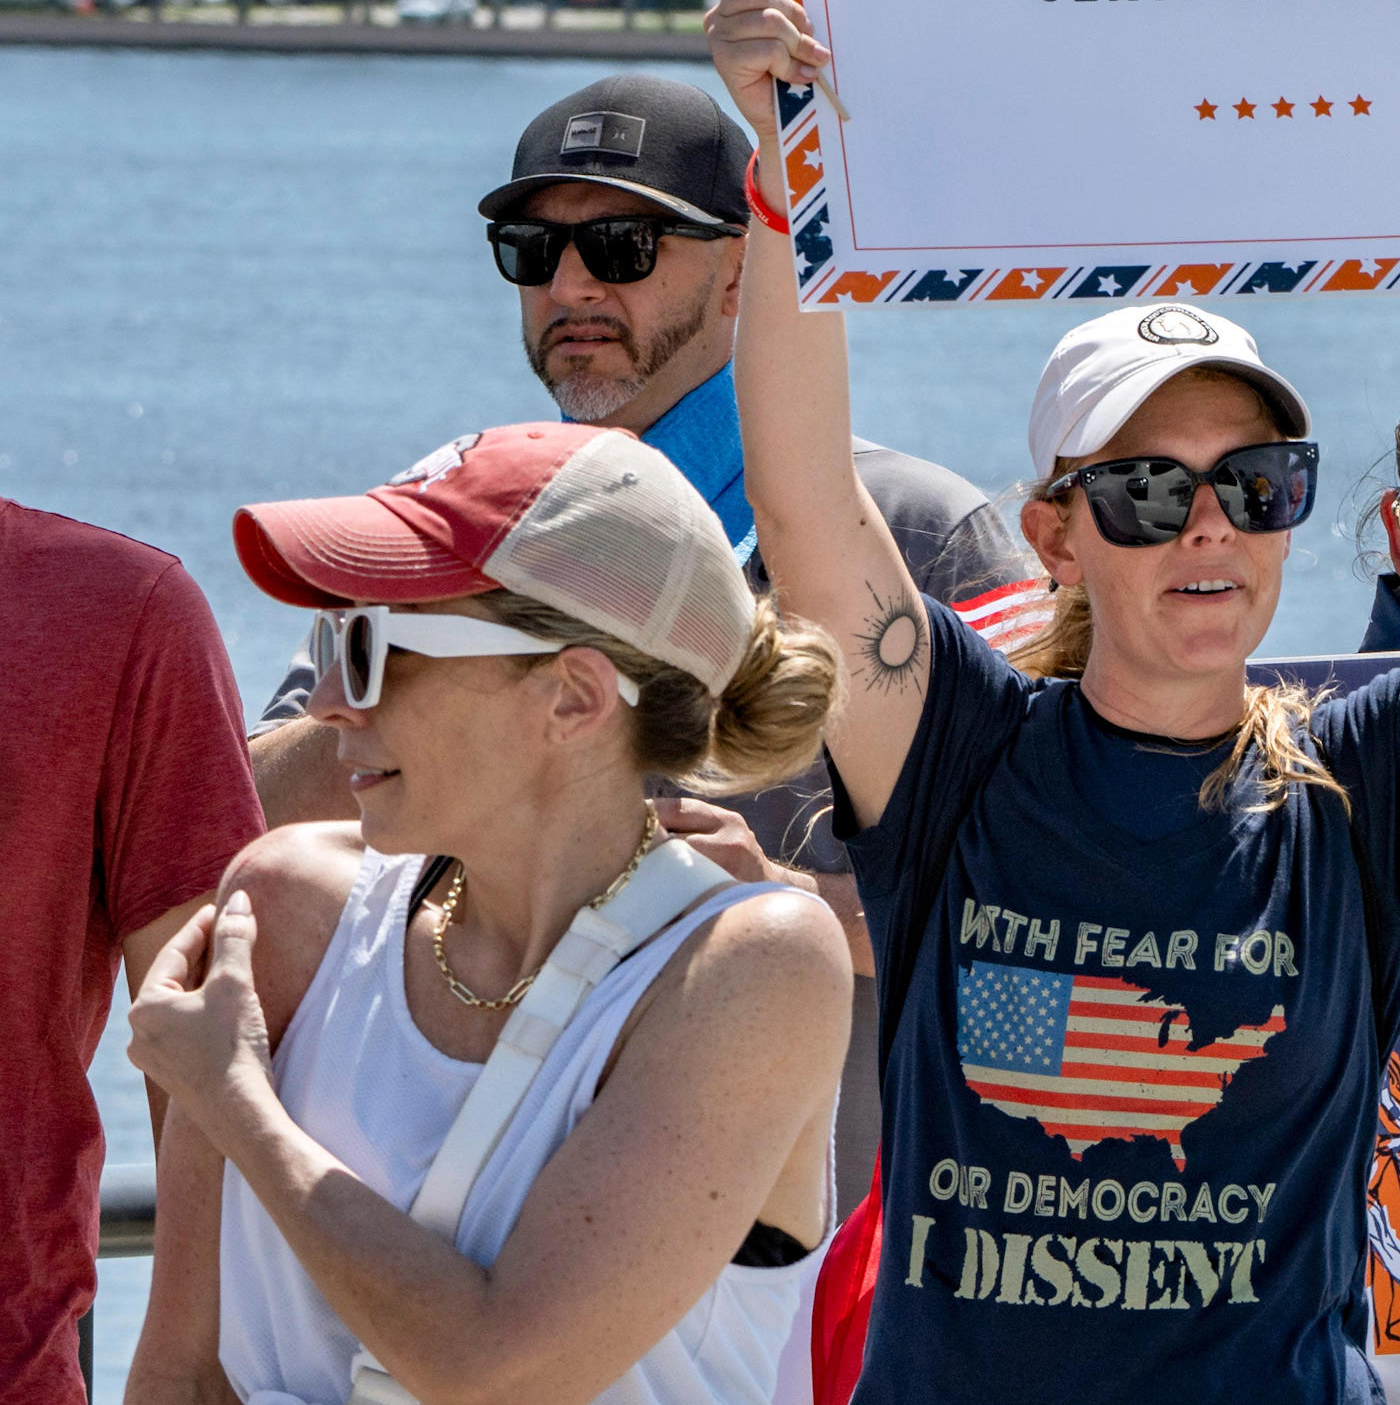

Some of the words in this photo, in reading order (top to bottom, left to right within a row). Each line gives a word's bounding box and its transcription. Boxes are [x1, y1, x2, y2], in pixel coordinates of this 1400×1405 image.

[1074, 922, 1199, 970] FEAR
[1214, 929, 1300, 978] FOR
[1004, 1171, 1276, 1224] DEMOCRACY
[905, 1214, 936, 1288] I
[954, 1228, 1266, 1310] DISSENT
